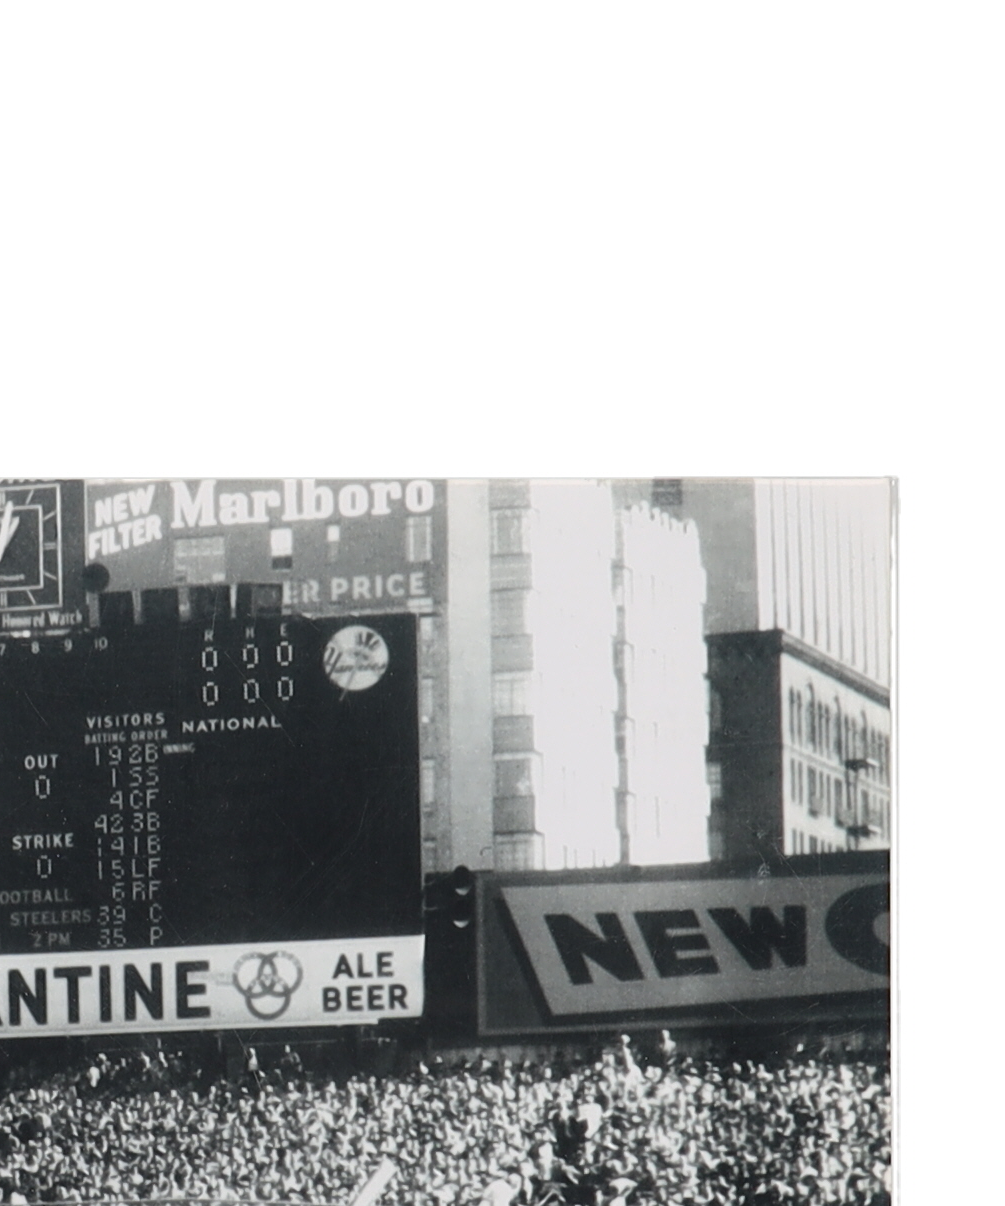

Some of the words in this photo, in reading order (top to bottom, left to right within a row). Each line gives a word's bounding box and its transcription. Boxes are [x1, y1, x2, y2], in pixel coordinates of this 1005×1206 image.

[95, 485, 155, 526] NEW
[170, 479, 434, 529] Marlboro
[88, 514, 162, 559] FILTER
[331, 572, 426, 599] PRICE
[47, 609, 83, 625] Watch
[280, 623, 288, 637] E
[0, 643, 7, 657] 7
[30, 641, 40, 654] 8
[64, 639, 73, 652] 9
[94, 637, 108, 651] 10
[86, 712, 165, 729] VISITORS
[182, 715, 282, 734] NATIONAL
[84, 731, 126, 745] BATTING
[131, 729, 168, 742] ORDER
[24, 754, 59, 770] OUT
[12, 832, 74, 850] STRIKE
[10, 909, 92, 927] STEELERS
[32, 934, 41, 947] 2
[48, 931, 71, 947] PM
[544, 904, 807, 986] NEW
[332, 951, 395, 980] ALE
[322, 983, 409, 1013] BEER
